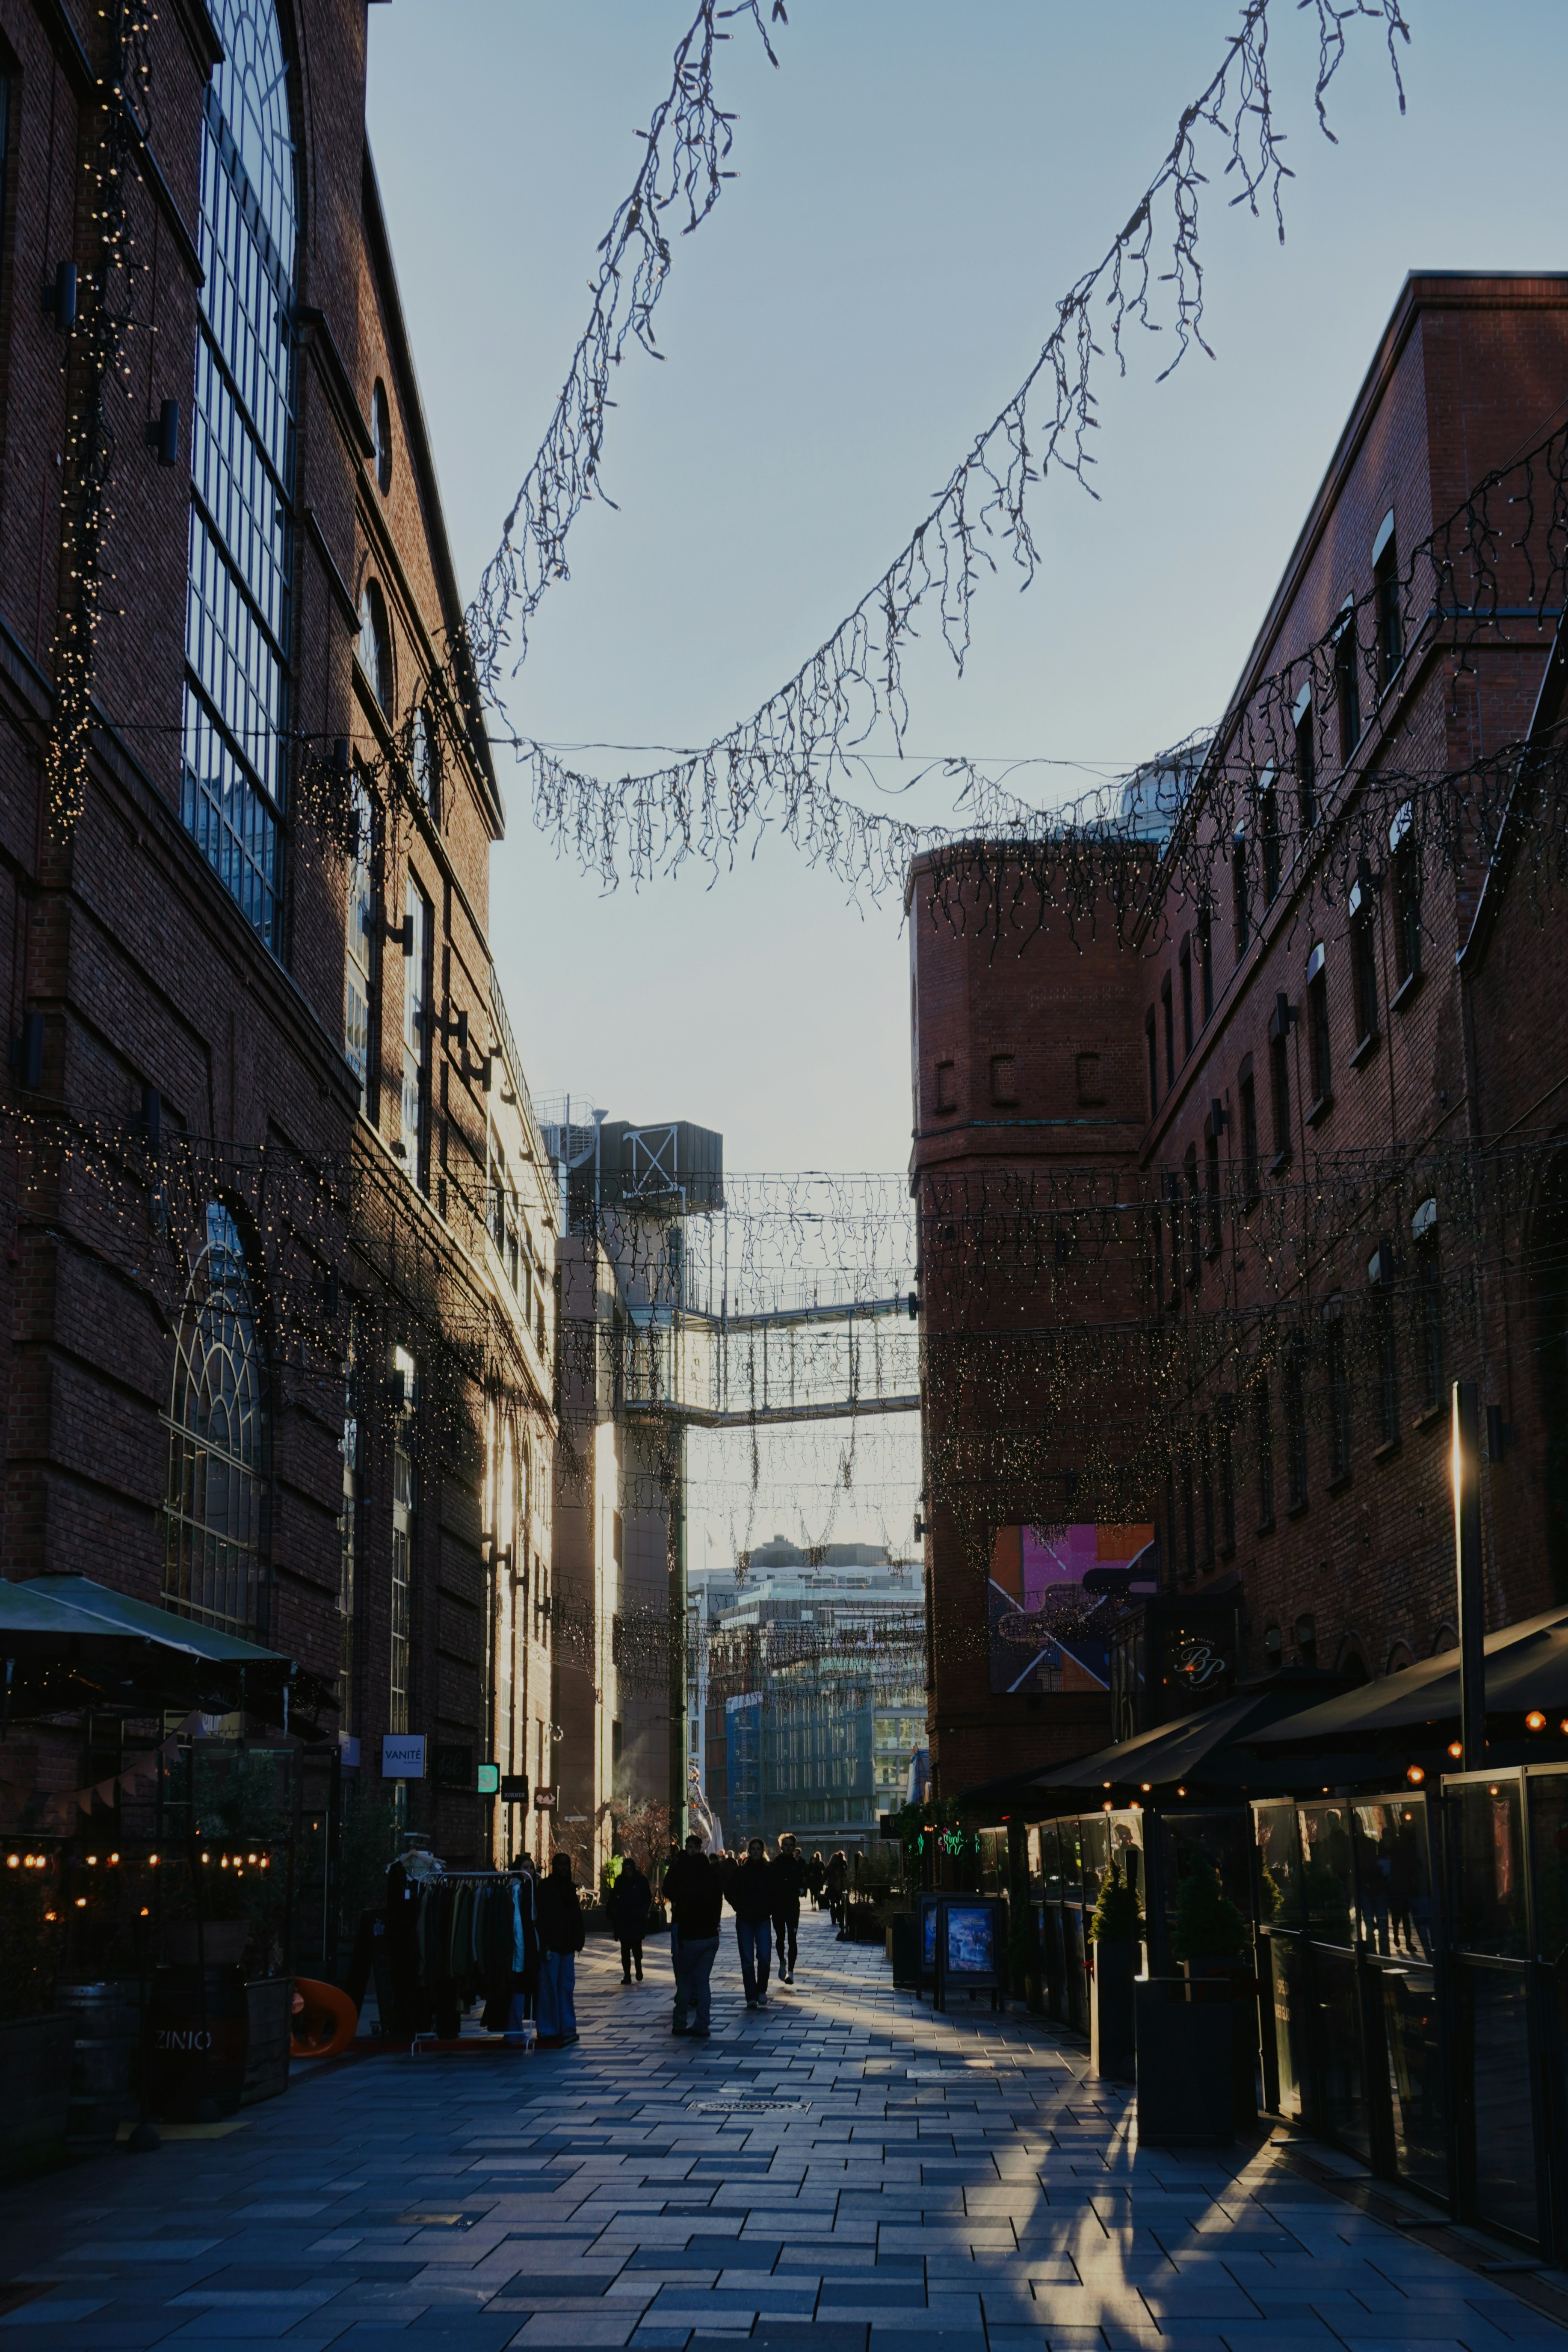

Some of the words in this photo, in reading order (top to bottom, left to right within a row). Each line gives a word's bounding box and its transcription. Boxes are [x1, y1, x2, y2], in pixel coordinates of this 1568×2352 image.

[1183, 1638, 1195, 1646] EE
[1197, 1638, 1215, 1646] PALACE
[385, 1748, 421, 1759] VANITÉ
[155, 2030, 212, 2050] ZINIO
